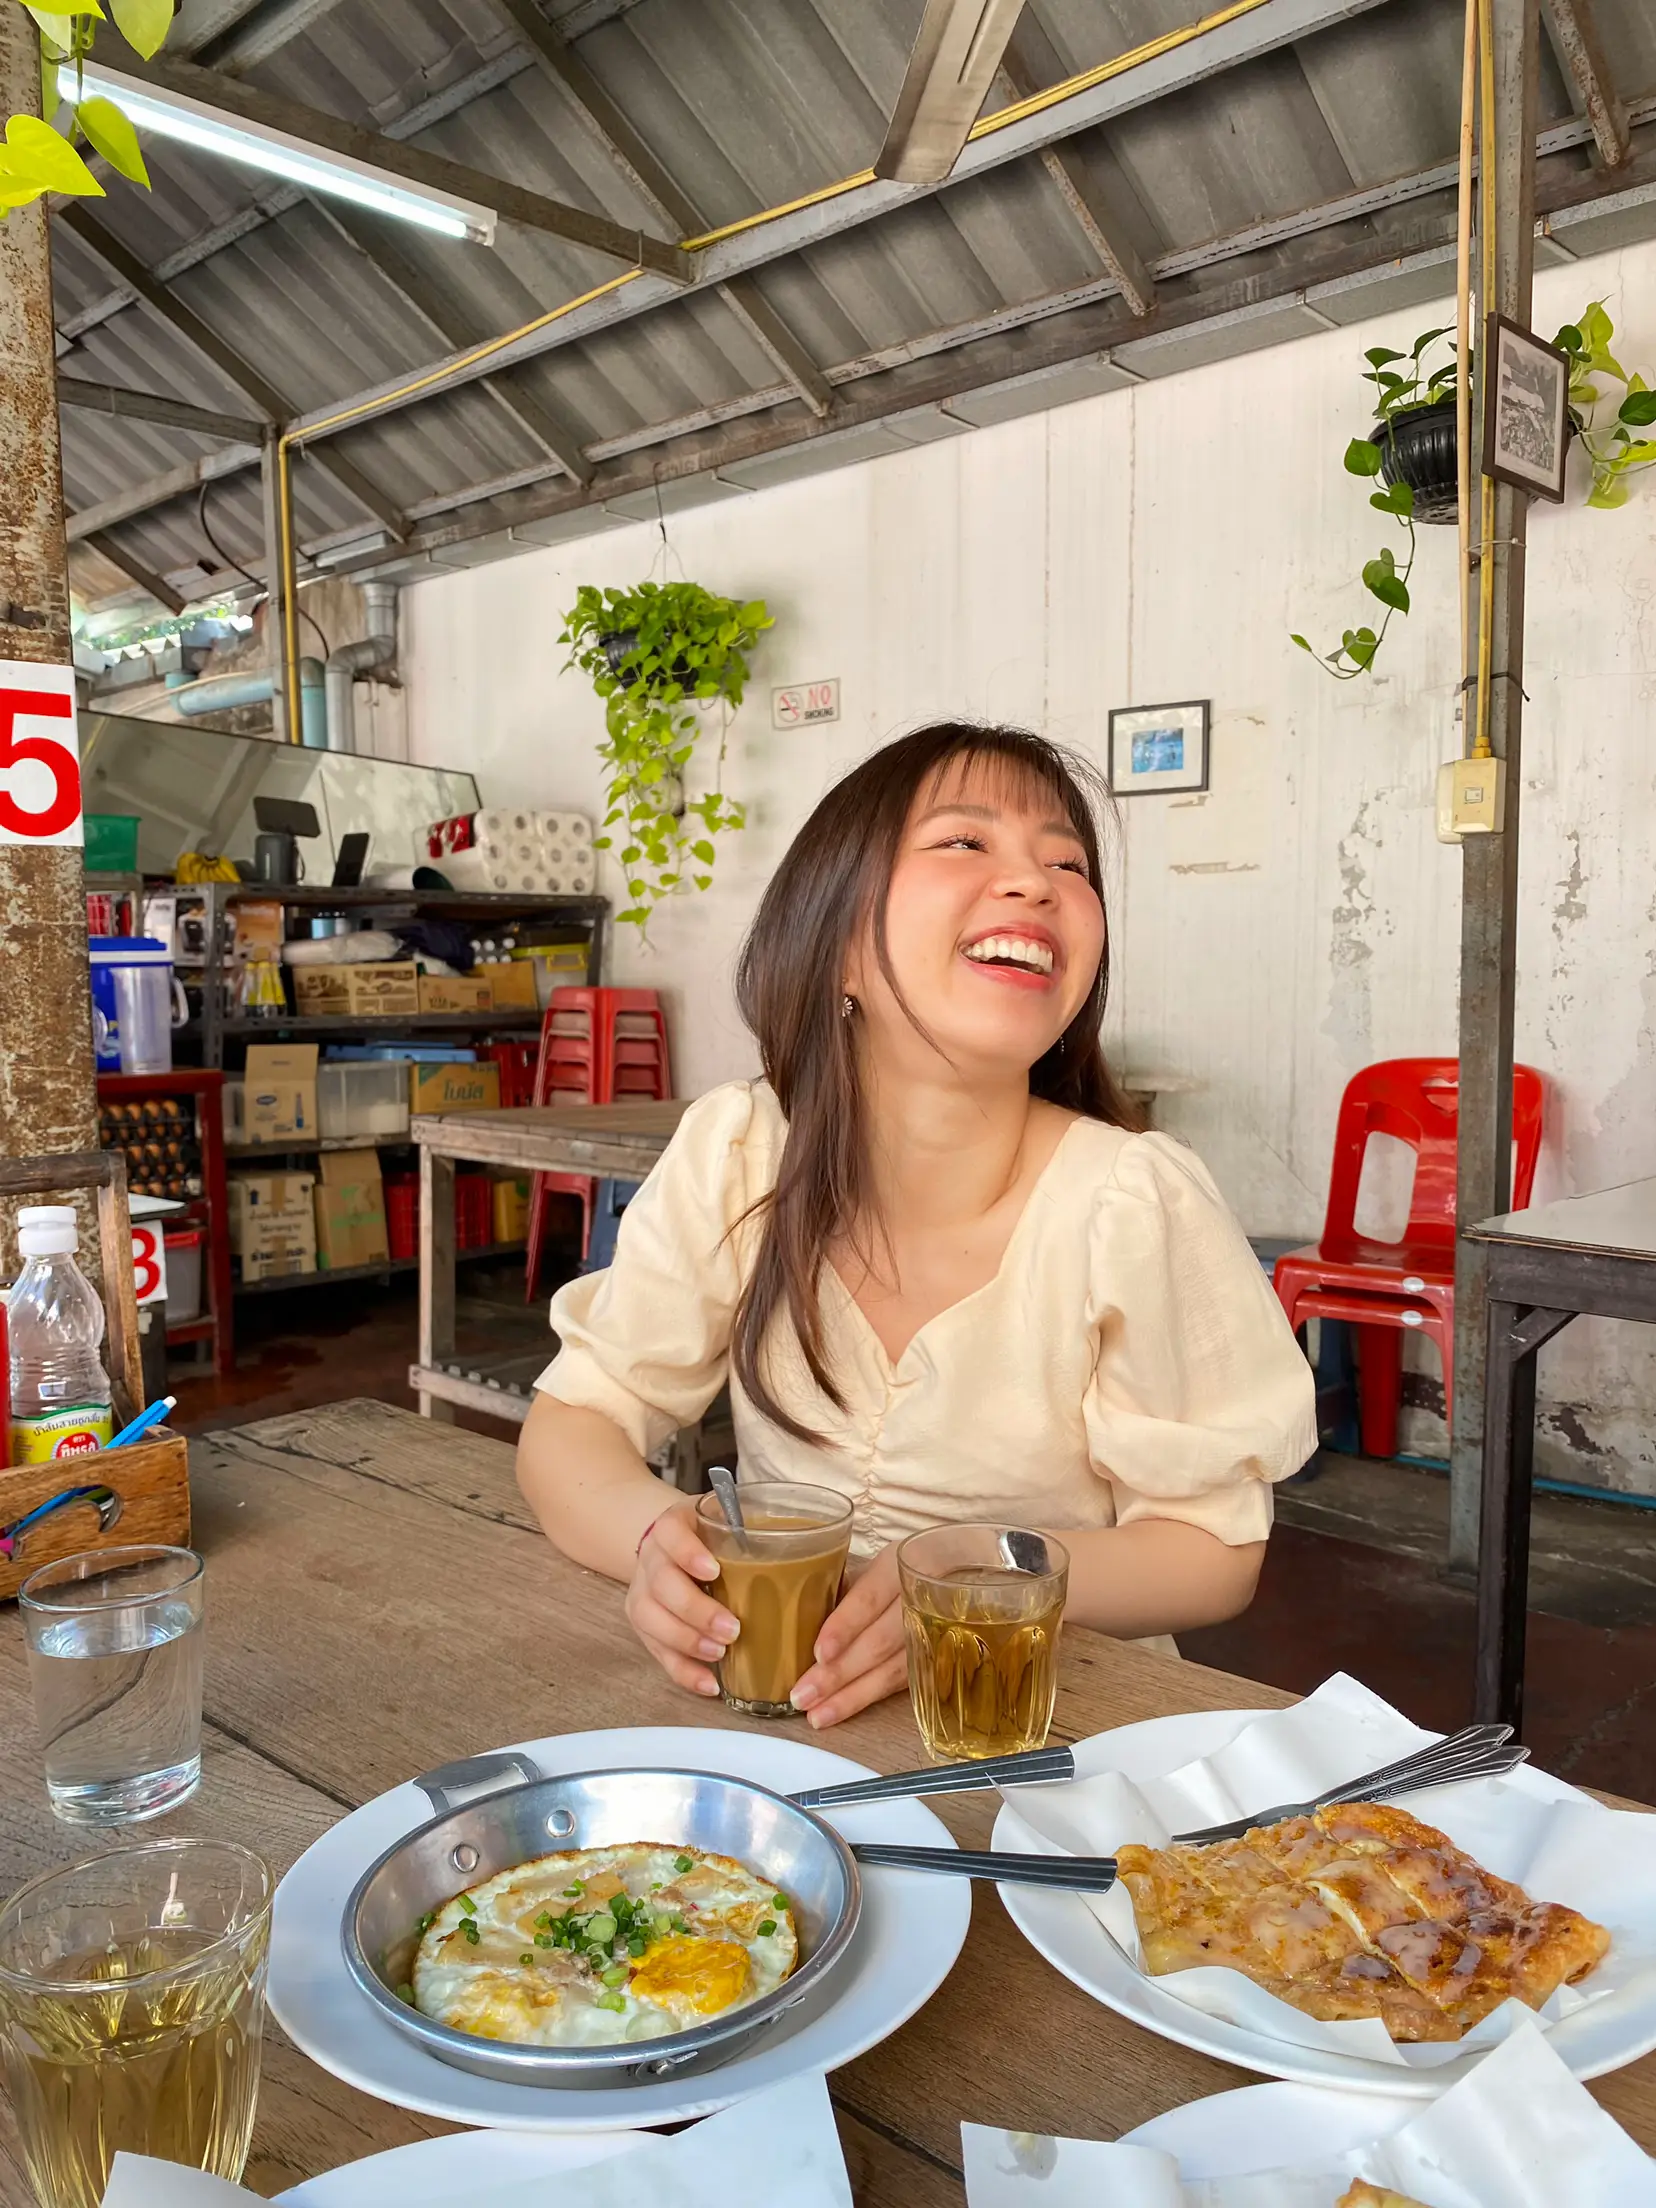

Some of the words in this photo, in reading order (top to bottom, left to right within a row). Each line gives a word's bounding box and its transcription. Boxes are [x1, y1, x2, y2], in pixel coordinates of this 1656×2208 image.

[808, 684, 831, 709] NO
[804, 706, 834, 720] SMOKING
[0, 688, 82, 838] 5
